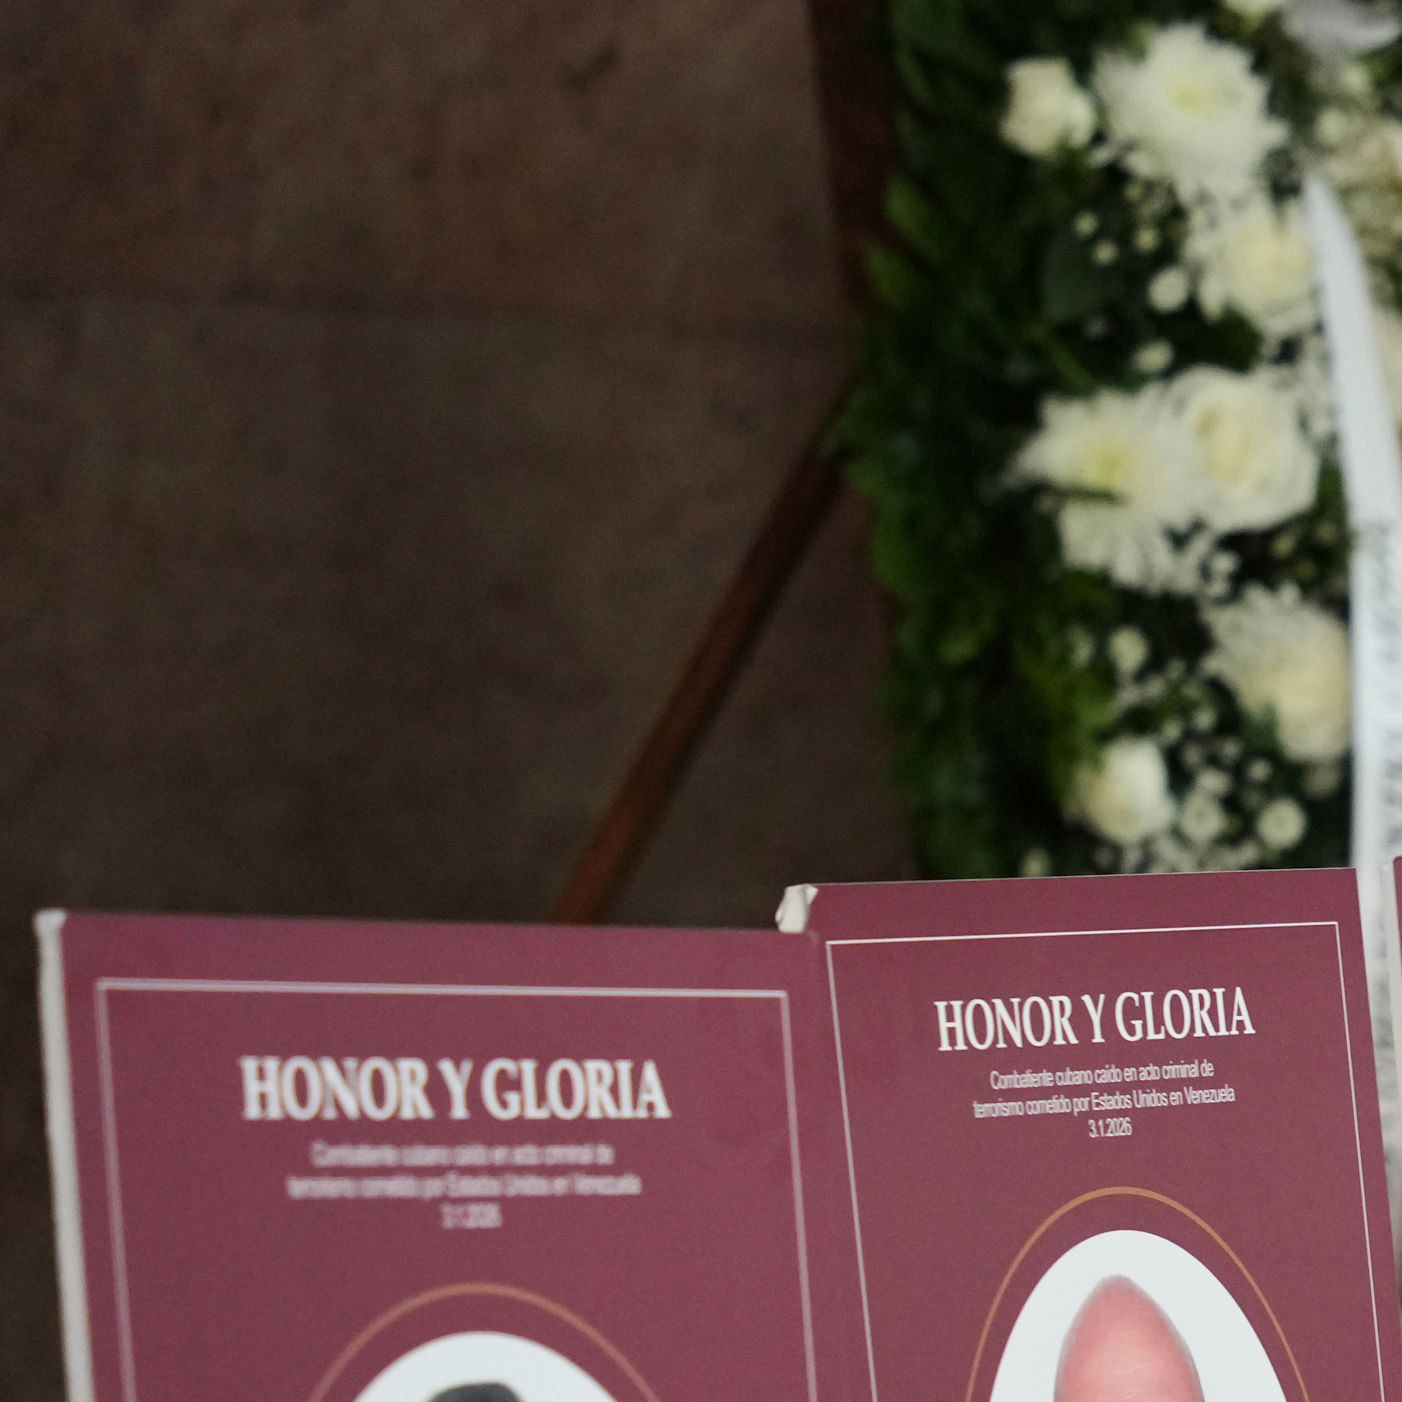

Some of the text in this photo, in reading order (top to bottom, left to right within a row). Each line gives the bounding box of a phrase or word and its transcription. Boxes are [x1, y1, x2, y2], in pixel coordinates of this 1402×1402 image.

[934, 986, 1257, 1052] HONOR Y GLORIA
[240, 1055, 672, 1121] HONOR Y GLORIA
[990, 1069, 1055, 1090] Combatiente
[1055, 1066, 1093, 1086] cubano
[1123, 1067, 1137, 1082] en
[1138, 1062, 1161, 1081] acto
[1161, 1059, 1200, 1079] criminal
[1200, 1058, 1215, 1078] de
[972, 1083, 1236, 1118] terrorismo cometido por Estados Unidos en Venezuela
